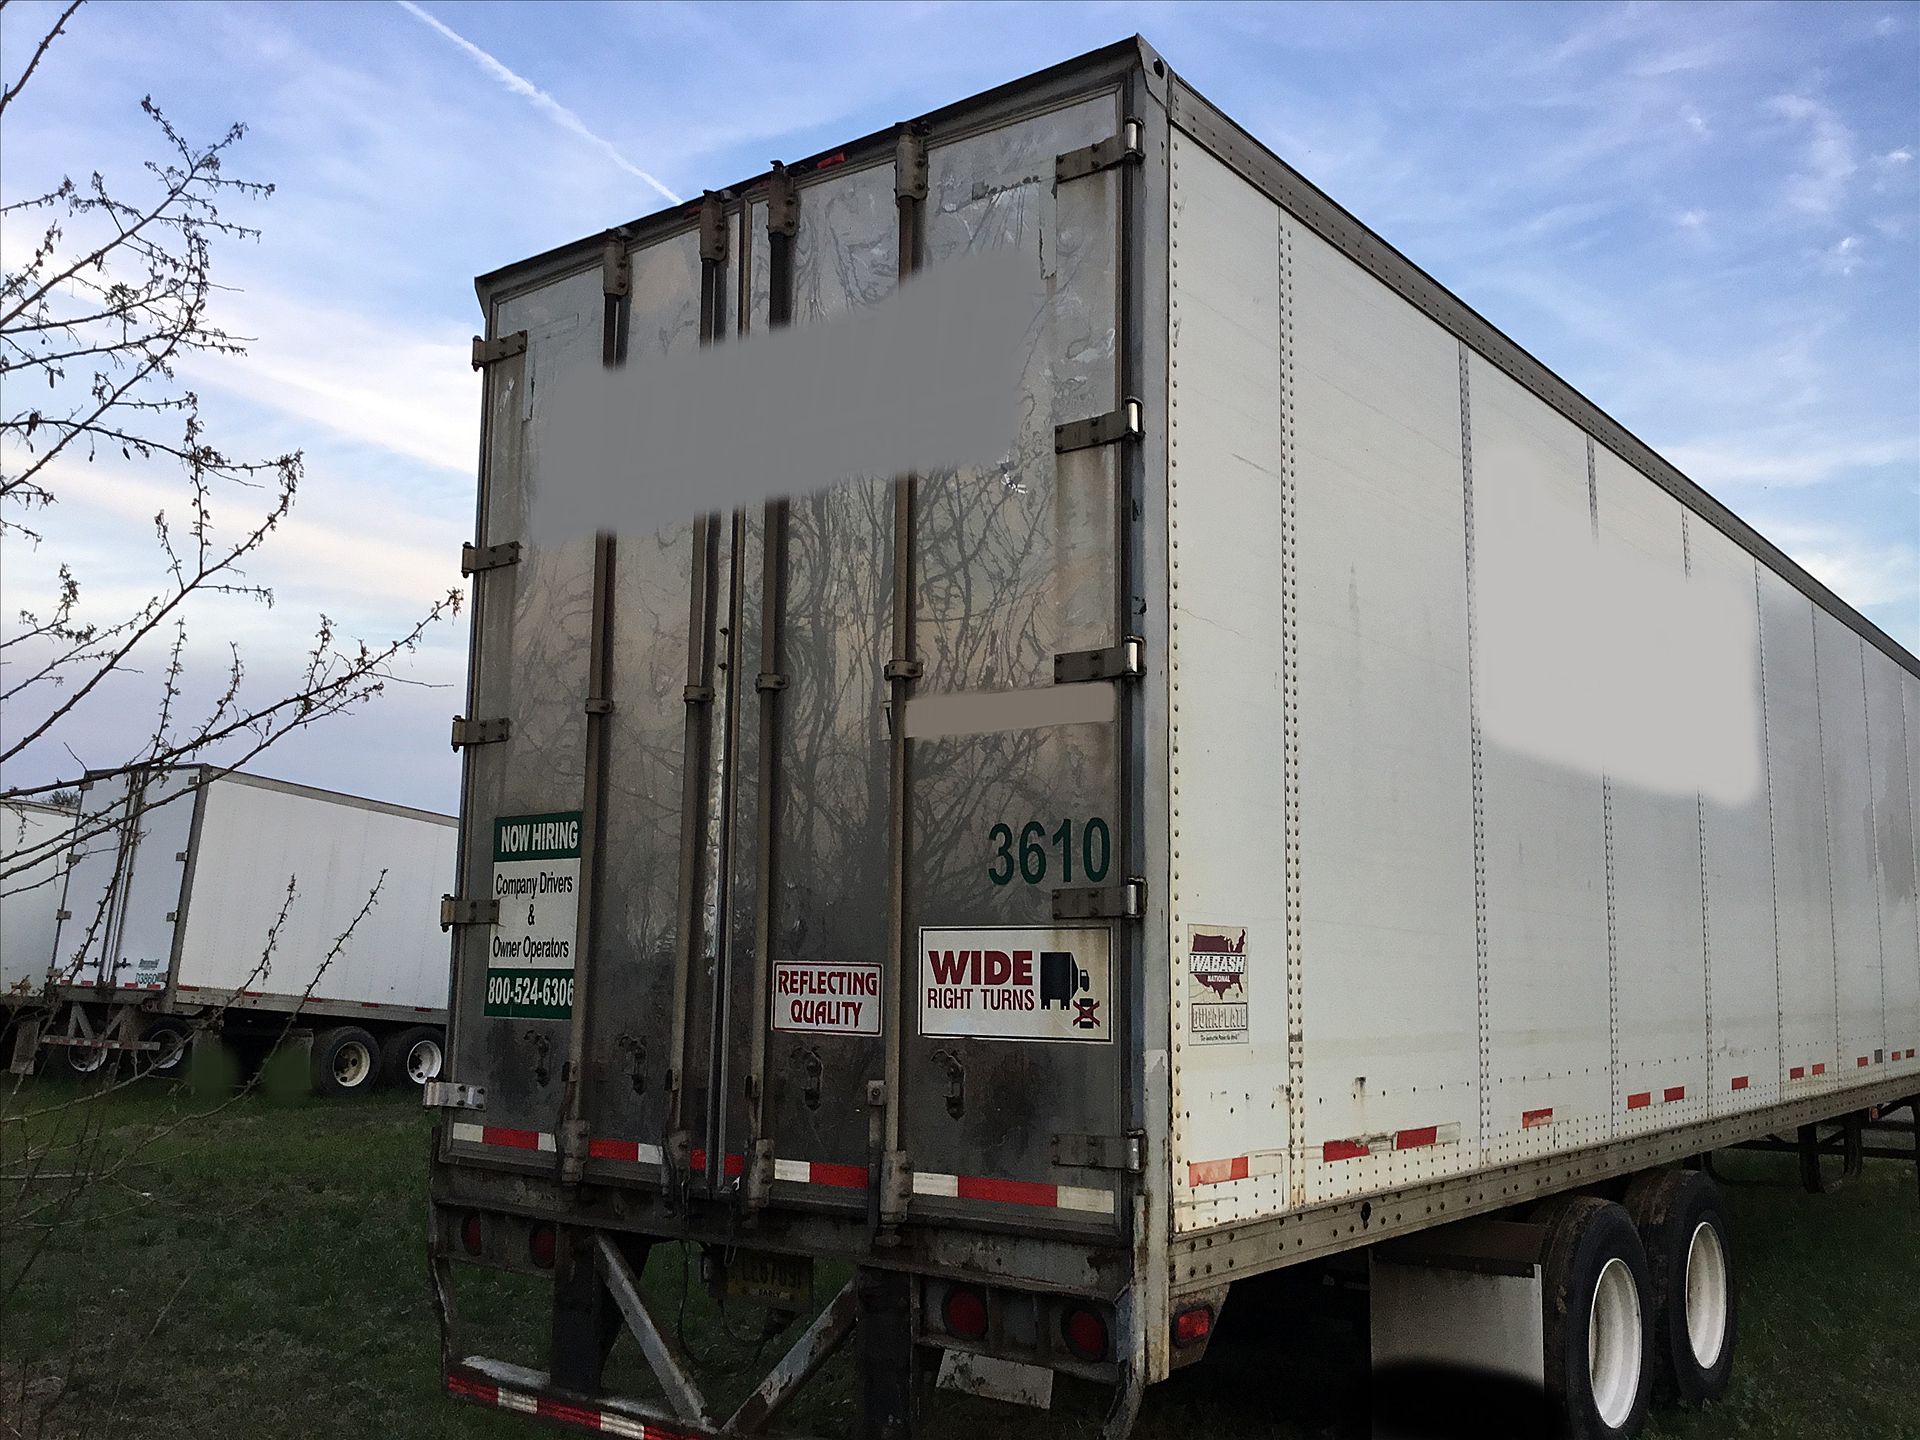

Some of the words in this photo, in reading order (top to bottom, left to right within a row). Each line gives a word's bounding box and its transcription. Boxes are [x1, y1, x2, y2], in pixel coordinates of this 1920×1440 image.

[501, 824, 530, 853] NOW
[532, 820, 578, 851] HIRING
[988, 817, 1111, 886] 3610
[495, 873, 538, 900] Company
[539, 871, 573, 894] Drivers
[527, 903, 535, 926] &
[493, 935, 521, 958] Owner
[522, 935, 569, 964] Operators
[1190, 956, 1245, 972] WABASH
[927, 950, 1034, 986] WIDE
[488, 977, 574, 1006] 800-524-6306
[778, 970, 878, 996] REFLECTING
[928, 988, 974, 1010] RIGHT
[981, 988, 1035, 1011] TURNS
[790, 1000, 863, 1029] QUALITY
